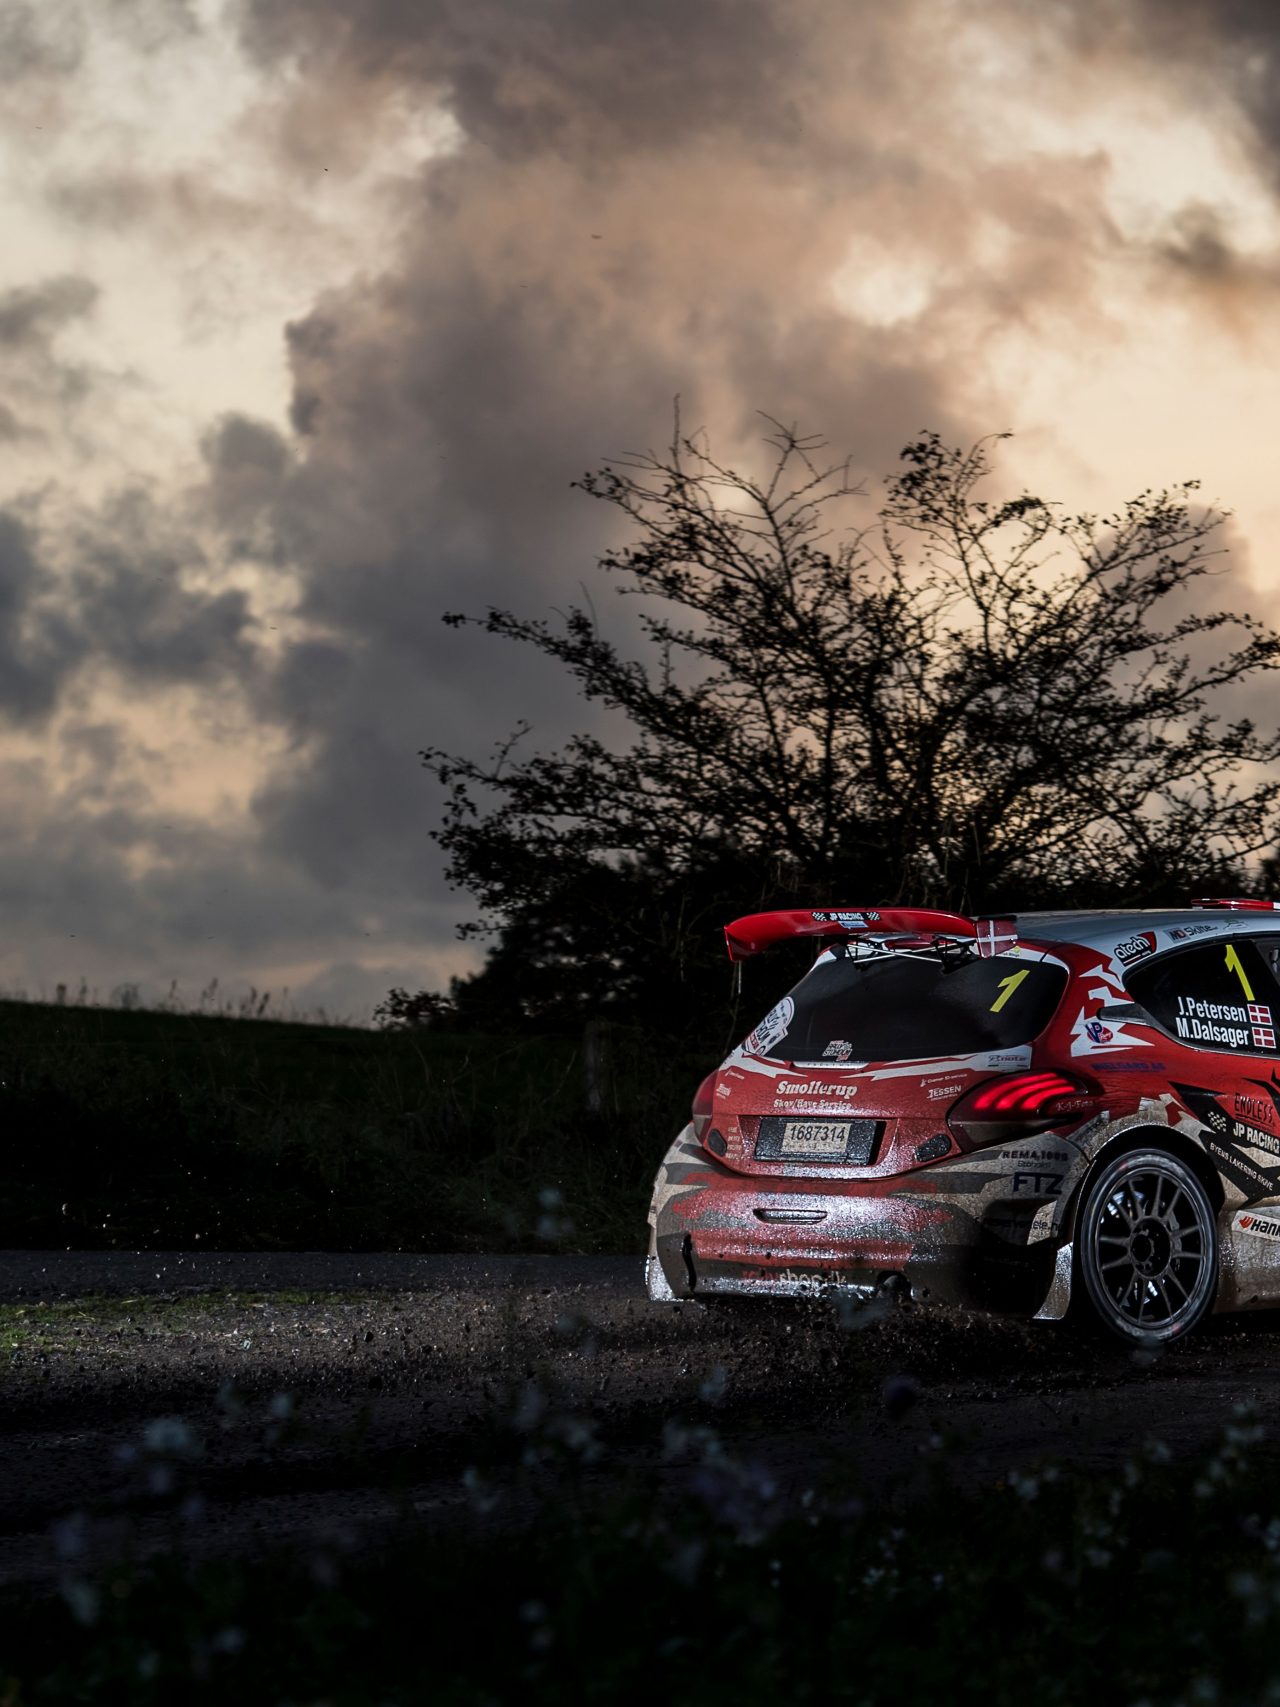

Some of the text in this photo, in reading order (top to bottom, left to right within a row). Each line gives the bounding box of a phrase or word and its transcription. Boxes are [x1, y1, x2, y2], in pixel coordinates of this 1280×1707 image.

[1224, 944, 1256, 1001] 1
[990, 969, 1030, 1012] 1
[1177, 996, 1247, 1023] J.Petersen
[1175, 1017, 1249, 1048] M.Dalsager
[776, 1080, 858, 1099] Smollerup
[790, 1125, 846, 1142] 1687314
[1233, 1122, 1280, 1154] JP RACING
[1002, 1150, 1038, 1160] REMA
[1210, 1142, 1229, 1160] BYENS
[1013, 1172, 1065, 1195] FTZ
